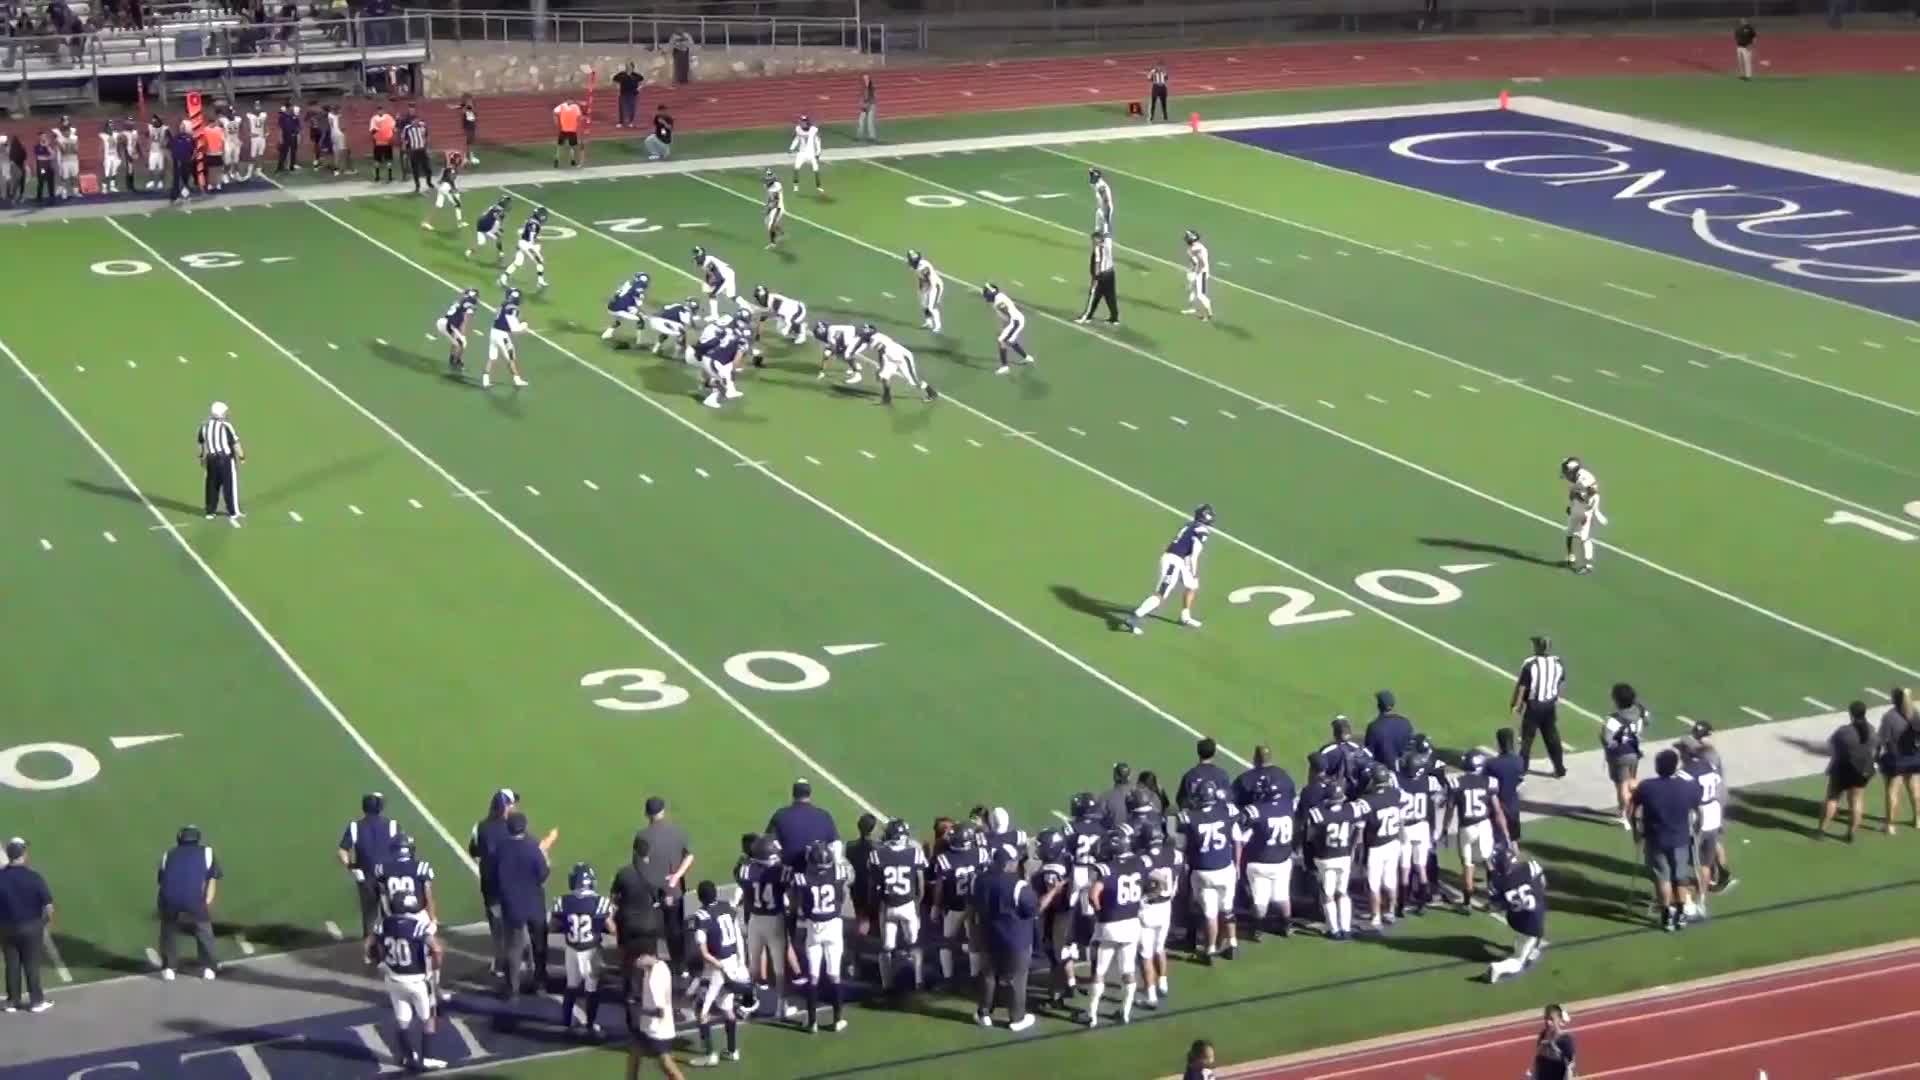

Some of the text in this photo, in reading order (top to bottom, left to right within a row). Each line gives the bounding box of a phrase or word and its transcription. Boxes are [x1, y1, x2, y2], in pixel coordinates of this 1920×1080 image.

[1400, 792, 1427, 820] 20
[1464, 788, 1488, 817] 15
[1326, 821, 1350, 848] 24
[1377, 806, 1401, 837] 72
[1198, 820, 1227, 854] 75
[883, 865, 912, 896] 25
[1117, 872, 1142, 906] 66
[752, 882, 777, 911] 14
[811, 884, 836, 914] 12
[567, 913, 594, 943] 32
[384, 937, 412, 967] 30
